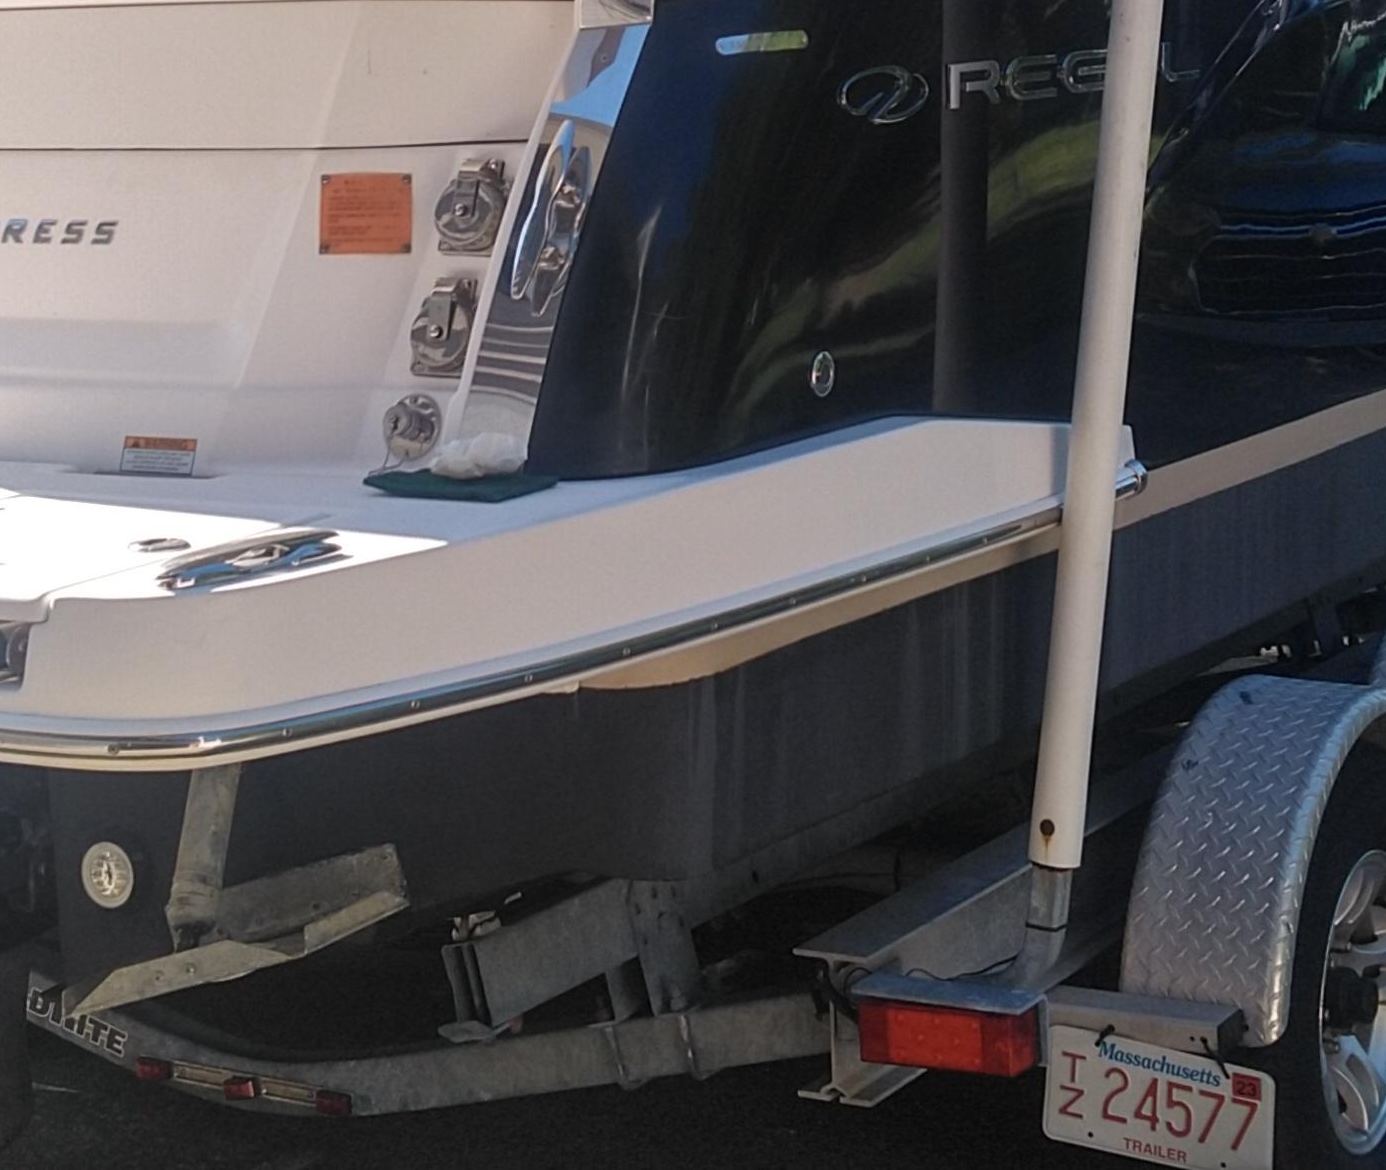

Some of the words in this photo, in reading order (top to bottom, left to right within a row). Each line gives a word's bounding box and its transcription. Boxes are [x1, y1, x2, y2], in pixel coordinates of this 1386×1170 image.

[945, 42, 1201, 110] REGL
[1097, 1040, 1222, 1088] Massachusetts
[1101, 1066, 1259, 1152] 24577
[1236, 1081, 1258, 1097] 23
[1123, 1136, 1188, 1164] TRAILER
